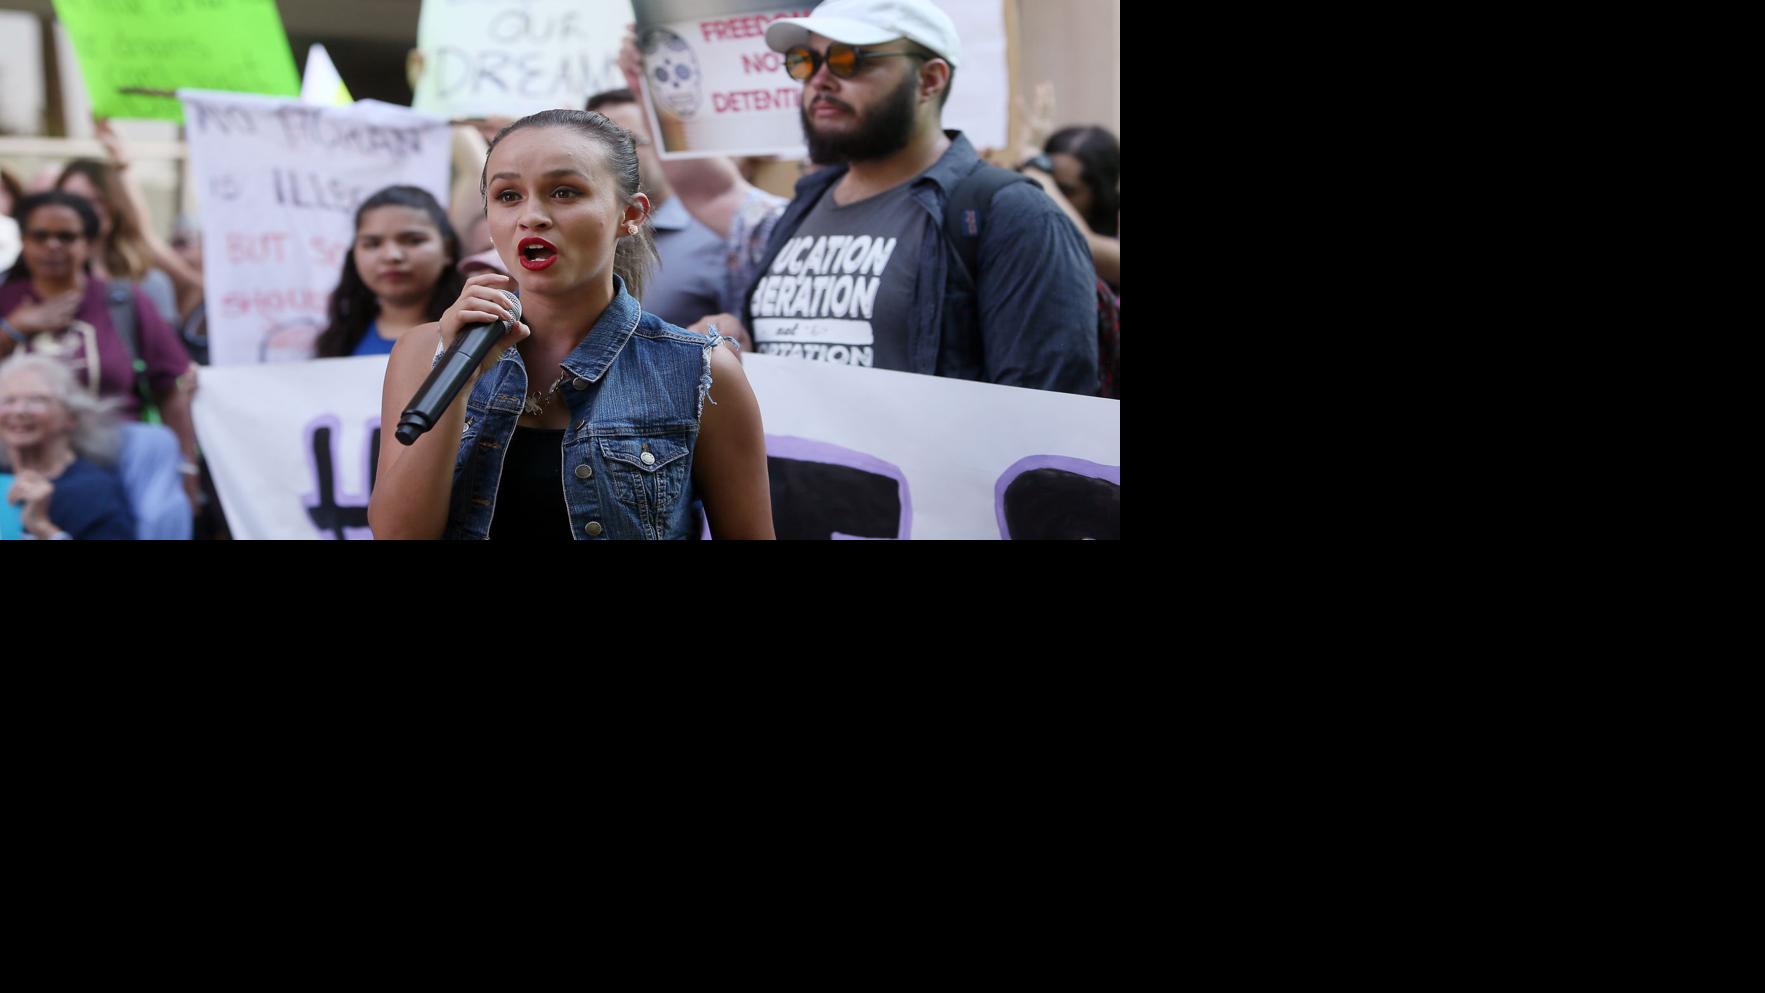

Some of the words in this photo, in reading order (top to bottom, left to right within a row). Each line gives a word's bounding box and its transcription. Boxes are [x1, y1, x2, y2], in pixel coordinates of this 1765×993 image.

[488, 8, 588, 44] OUR
[699, 9, 811, 43] FREED
[740, 51, 780, 75] NO
[225, 231, 289, 266] BUT
